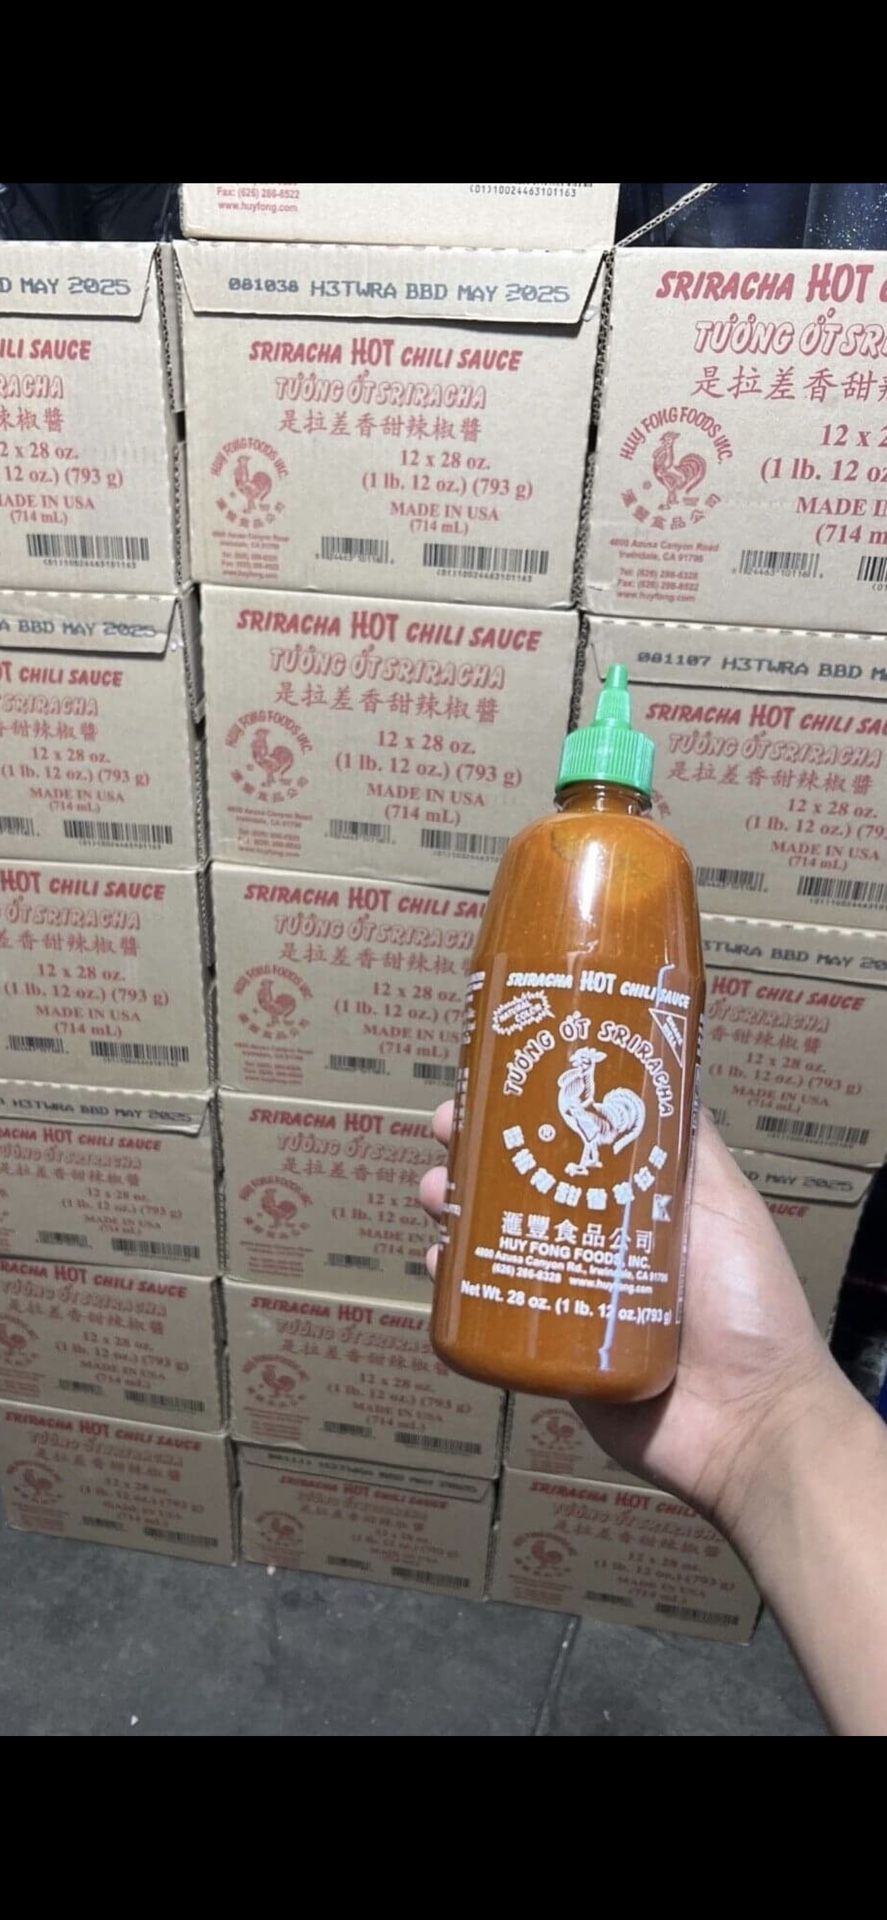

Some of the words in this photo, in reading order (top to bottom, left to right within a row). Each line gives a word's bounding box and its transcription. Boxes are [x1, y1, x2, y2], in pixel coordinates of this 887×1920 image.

[20, 278, 59, 294] MAY
[68, 276, 131, 294] 2025
[229, 278, 299, 292] 081038
[311, 281, 397, 298] H3TWRA
[406, 283, 447, 299] BBD
[457, 285, 498, 301] MAY
[505, 284, 570, 303] 2025
[656, 270, 795, 301] SRIRACHA
[806, 263, 874, 302] HOT
[0, 340, 24, 358] ILI
[30, 339, 91, 360] SAUCE
[249, 341, 341, 364] SRIRACHA
[351, 338, 395, 367] HOT
[400, 346, 450, 368] CHILI
[457, 349, 522, 371] SAUCE
[691, 365, 887, 403] 是拉差香甜
[619, 426, 647, 461] HUY
[641, 407, 677, 434] FONG
[680, 406, 722, 439] FOODS
[822, 424, 848, 447] 12
[857, 430, 871, 447] x
[878, 426, 887, 448] 2
[400, 451, 418, 467] 12
[426, 455, 435, 468] x
[441, 452, 461, 469] 28
[467, 457, 490, 470] oz.
[5, 466, 26, 482] 12
[30, 468, 59, 484] oz.)
[65, 468, 100, 485] (793
[107, 470, 123, 488] g)
[362, 471, 378, 492] (1
[384, 472, 404, 491] lb.
[412, 474, 430, 491] 12
[436, 477, 467, 495] oz.)
[473, 477, 510, 497] (793
[515, 479, 533, 500] g)
[390, 501, 438, 518] MADE
[444, 504, 462, 519] IN
[467, 505, 498, 521] USA
[796, 496, 867, 516] MADE
[19, 620, 55, 634] BBD
[63, 622, 95, 636] MAY
[103, 622, 157, 637] 2025
[237, 609, 341, 637] SRIRACHA
[351, 611, 399, 642] HOT
[406, 622, 462, 646] CHILI
[469, 628, 542, 652] SAUCE
[19, 666, 63, 684] CHILI
[68, 669, 123, 687] SAUCE
[638, 652, 710, 666] 081107
[722, 658, 809, 675] H3TWRA
[818, 663, 862, 678] BBD
[645, 703, 741, 725] SRIRACHA
[750, 705, 796, 730] HOT
[800, 714, 852, 733] CHILI
[856, 719, 887, 735] SAU
[378, 731, 398, 748] 12
[405, 737, 414, 749] x
[421, 734, 444, 752] 28
[451, 739, 476, 755] oz.
[335, 753, 351, 771] (1
[359, 754, 382, 772] lb.
[390, 757, 409, 774] 12
[416, 760, 450, 781] oz.)
[456, 763, 497, 783] (793
[504, 768, 522, 788] g)
[0, 869, 41, 894] HOT
[50, 878, 99, 896] CHILI
[104, 882, 165, 900] SAUCE
[244, 884, 339, 906] SRIRACHA
[349, 887, 392, 912] HOT
[398, 896, 450, 916] CHILI
[770, 948, 809, 962] BBD
[816, 953, 854, 968] MAY
[507, 972, 573, 989] SRIRACHA
[580, 971, 617, 995] HOT
[620, 981, 657, 1001] CHILI
[712, 976, 752, 998] HOT
[756, 985, 804, 1004] CHILI
[806, 992, 865, 1010] SAUCE
[36, 1006, 84, 1017] MADE
[89, 1008, 104, 1018] IN
[110, 1010, 141, 1021] USA
[598, 1021, 674, 1118] SRIRACHA
[249, 1108, 336, 1129] SRIRACHA
[345, 1113, 384, 1135] HOT
[43, 1128, 73, 1144] HOT
[79, 1134, 114, 1146] CHILI
[118, 1138, 162, 1152] SAUCE
[500, 1237, 526, 1250] HUY
[530, 1243, 571, 1259] FONG
[629, 1255, 650, 1269] INC.
[526, 1255, 564, 1272] Canyon
[636, 1270, 648, 1281] CA
[54, 1266, 88, 1284] HOT
[94, 1275, 134, 1291] CHILI
[138, 1283, 188, 1299] SAUCE
[461, 1281, 479, 1297] Net
[483, 1284, 503, 1302] Wt.
[508, 1290, 525, 1306] 28
[528, 1296, 550, 1310] oz.
[555, 1298, 569, 1315] (1
[574, 1301, 593, 1316] lb.
[251, 1297, 331, 1318] SRIRACHA
[338, 1299, 374, 1324] HOT
[379, 1313, 422, 1330] CHILI
[80, 1420, 110, 1439] HOT
